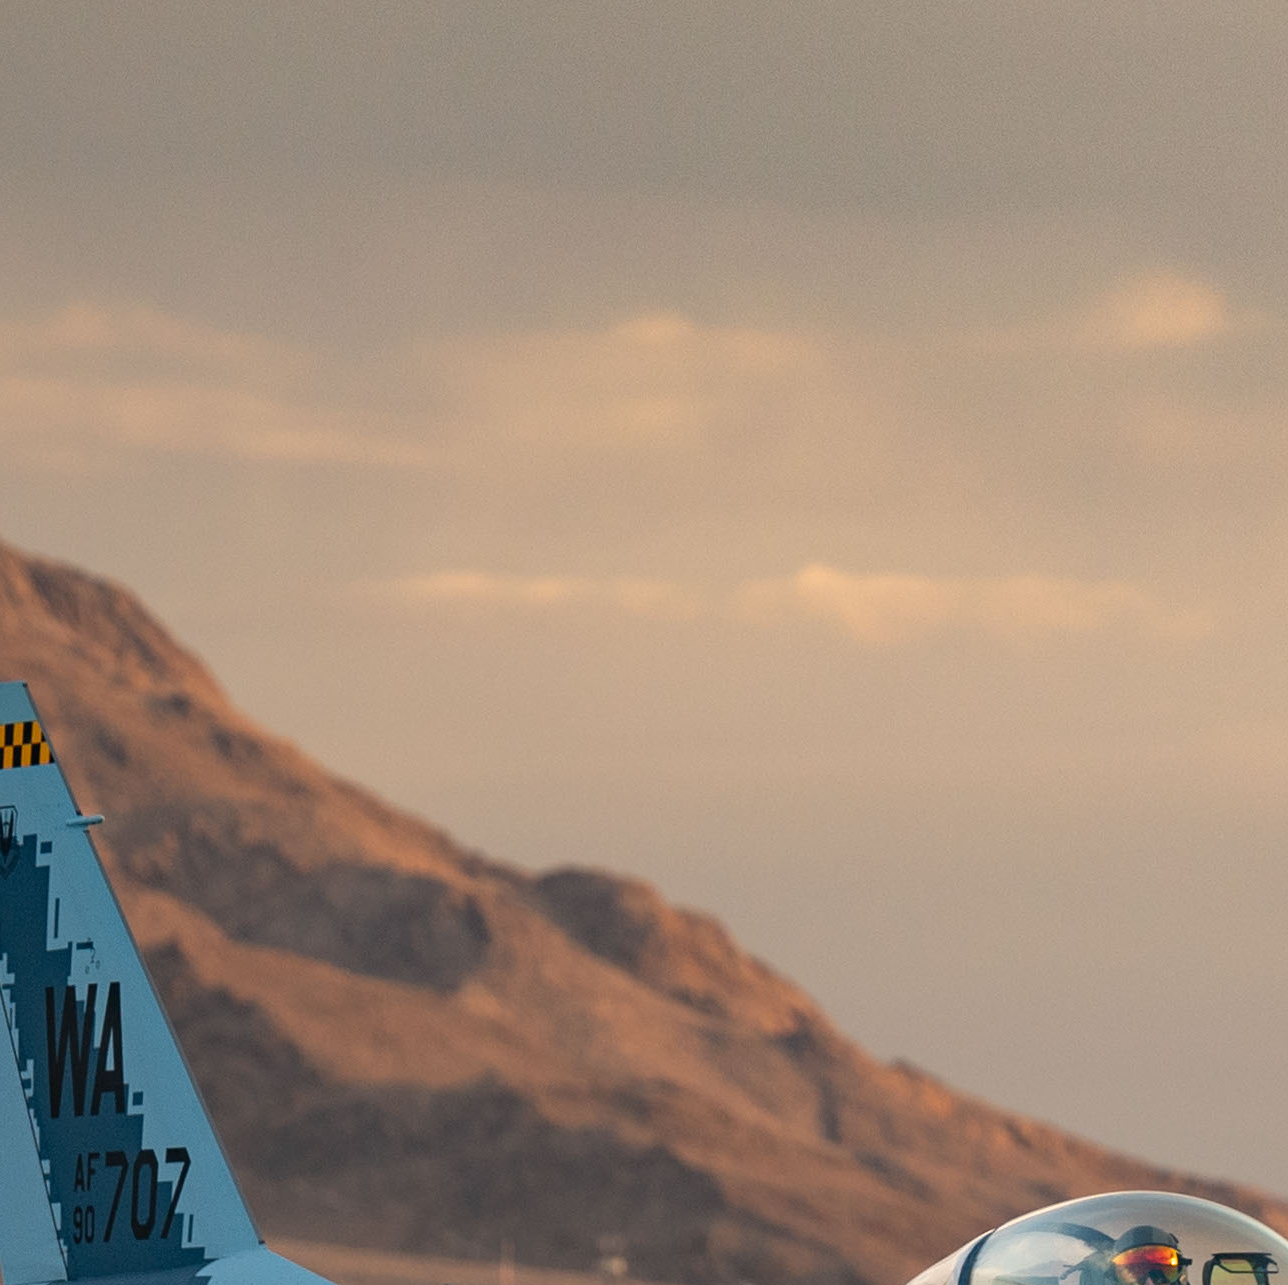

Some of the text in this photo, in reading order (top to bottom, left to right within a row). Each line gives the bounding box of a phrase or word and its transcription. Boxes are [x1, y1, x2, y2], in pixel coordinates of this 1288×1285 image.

[44, 981, 126, 1118] WA
[73, 1152, 100, 1192] AF
[103, 1147, 191, 1243] 707
[72, 1204, 95, 1244] 90
